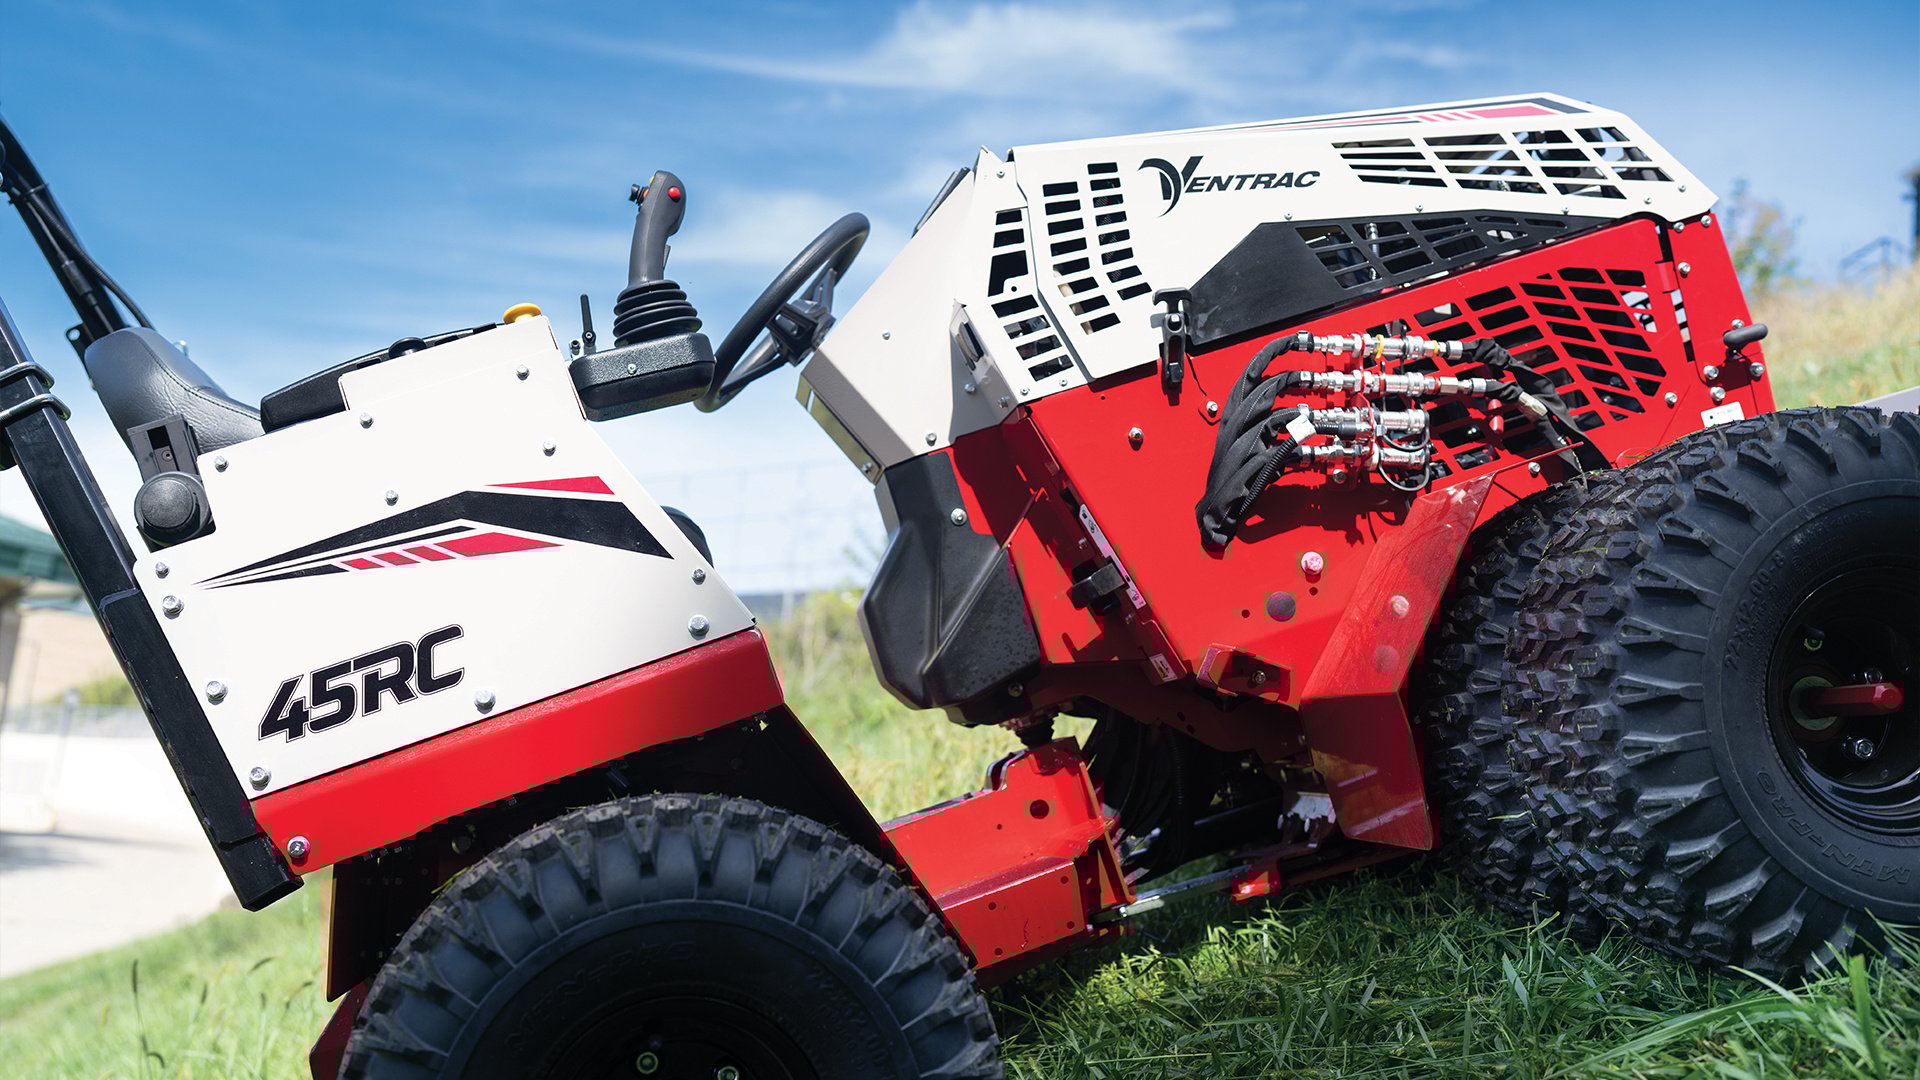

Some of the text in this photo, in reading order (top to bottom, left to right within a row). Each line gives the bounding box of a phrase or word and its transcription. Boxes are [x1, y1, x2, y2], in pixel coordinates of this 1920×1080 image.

[1137, 155, 1321, 218] VENTRAC
[258, 623, 465, 743] 45RC
[1756, 770, 1913, 885] MTN-PRO
